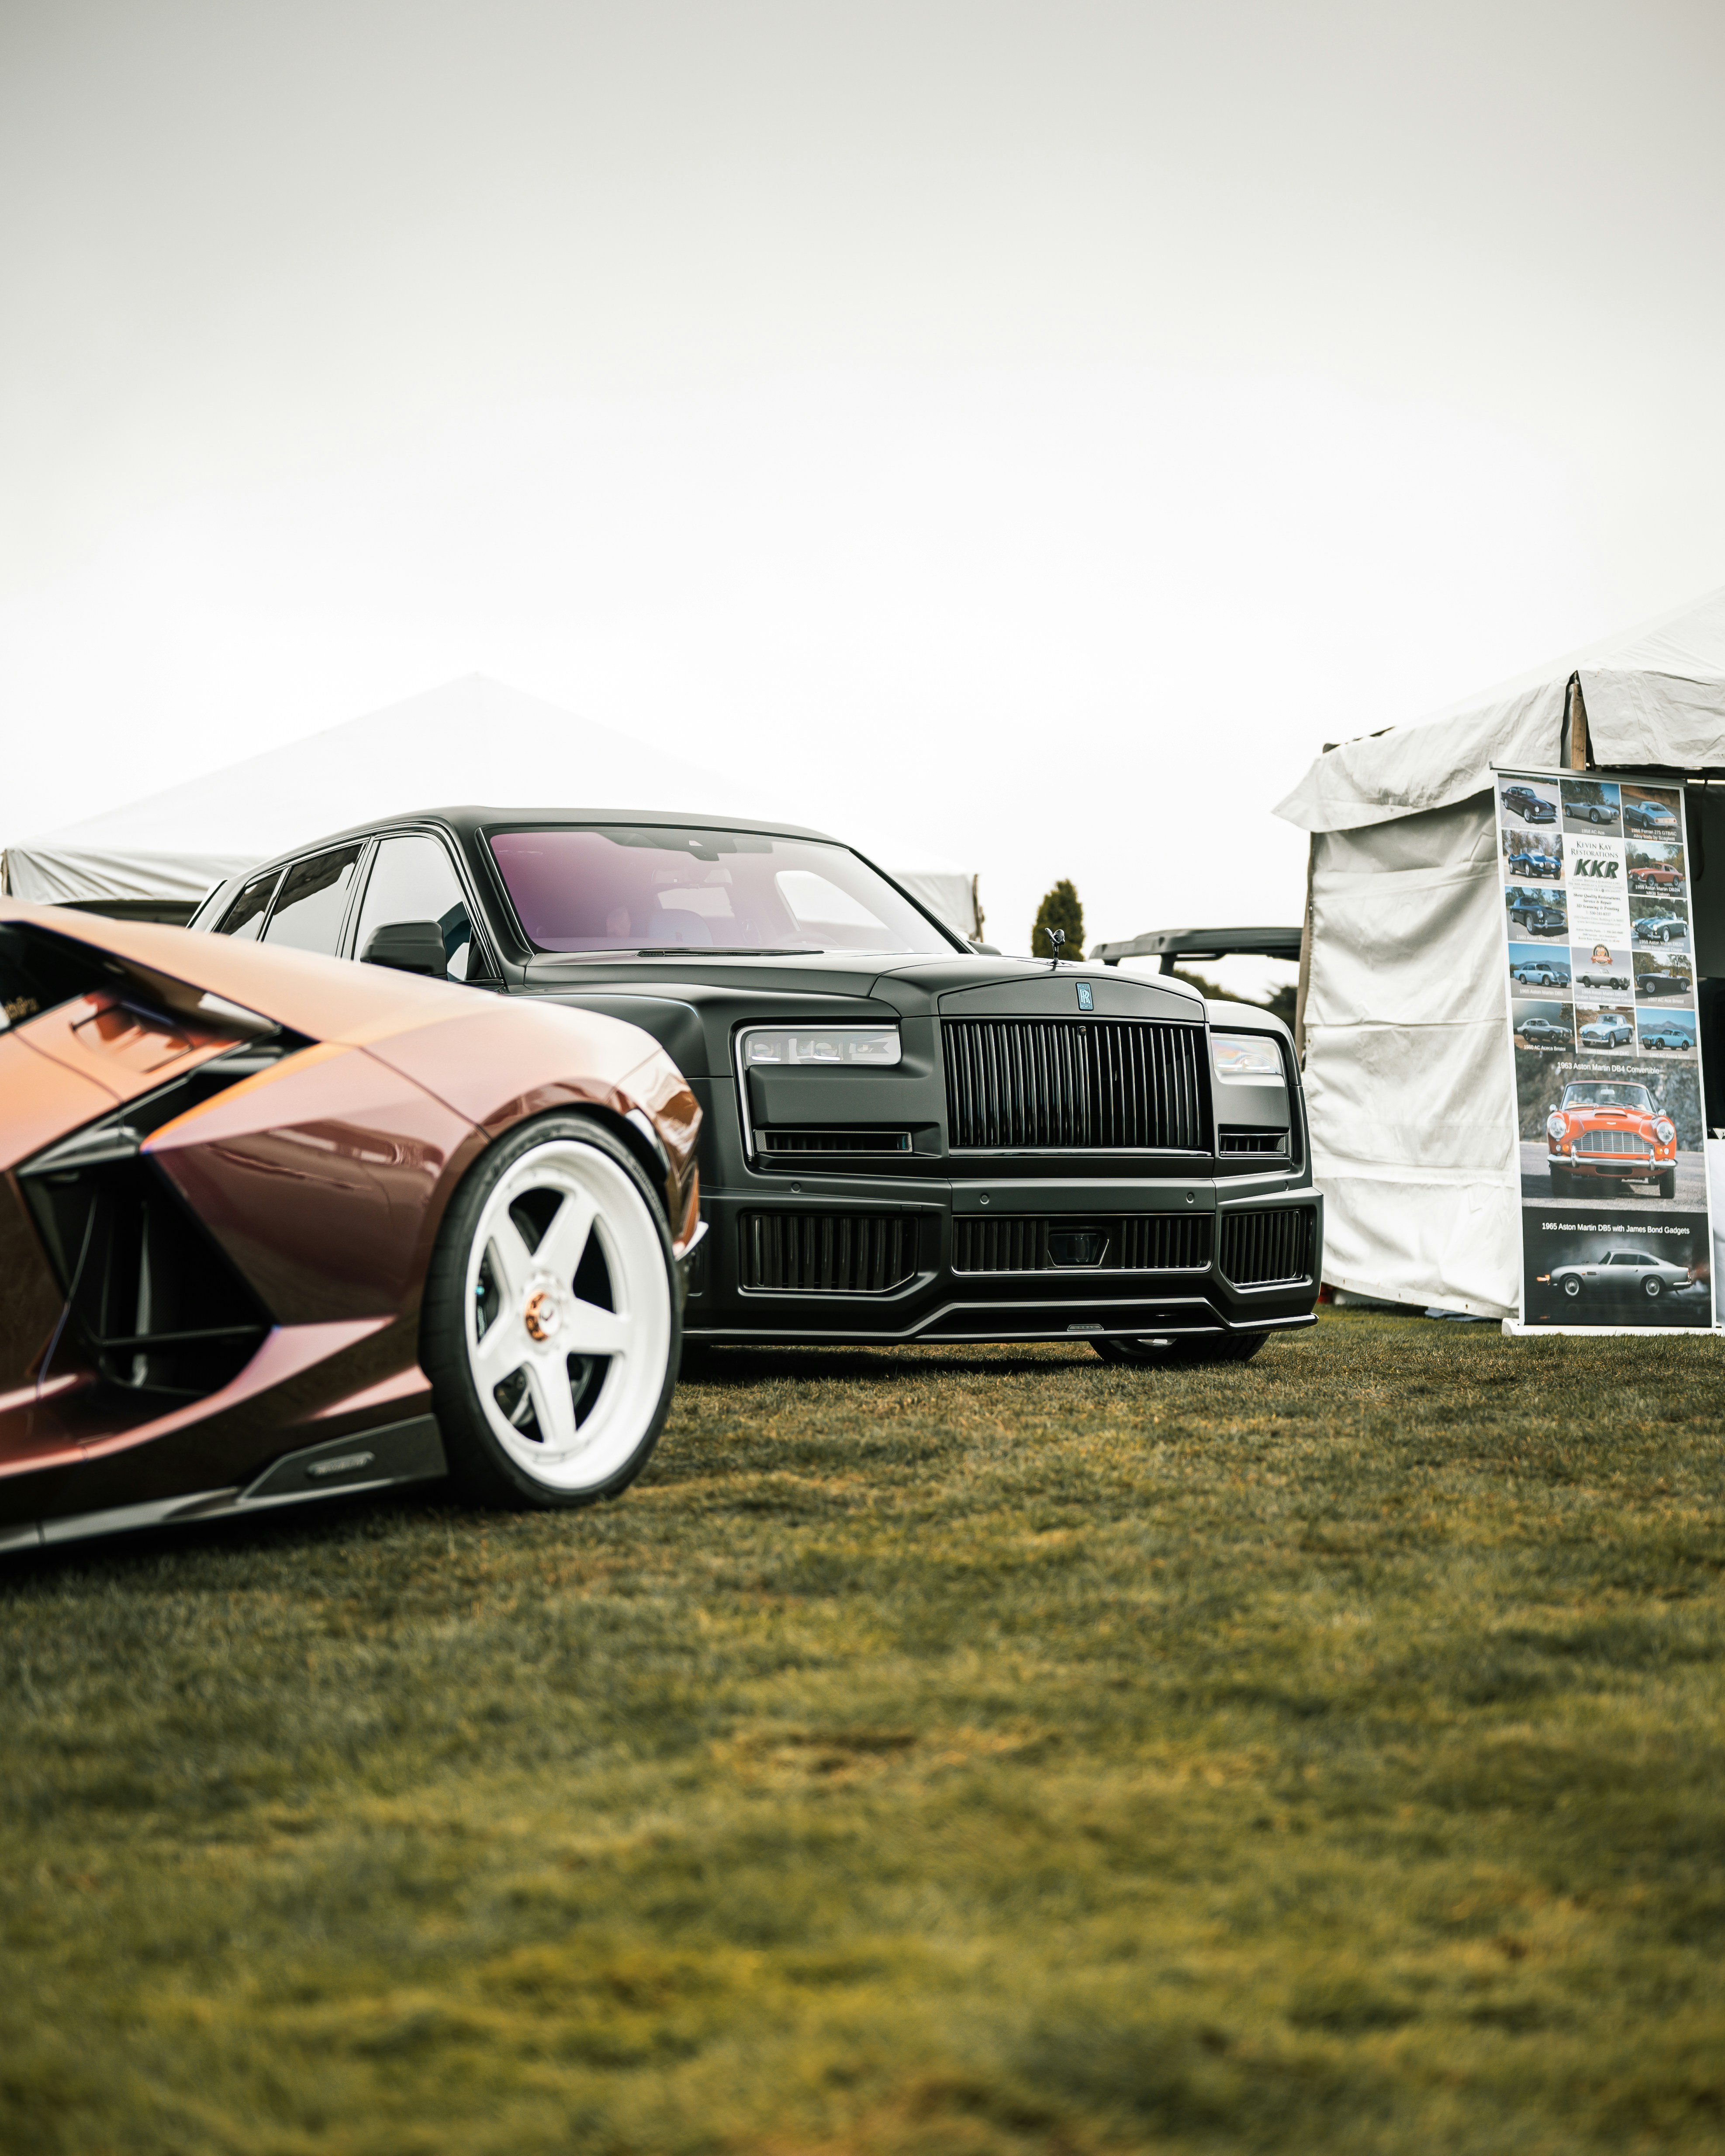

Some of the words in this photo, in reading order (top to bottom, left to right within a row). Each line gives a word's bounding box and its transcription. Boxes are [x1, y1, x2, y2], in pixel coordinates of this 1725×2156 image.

[1571, 848, 1618, 858] RESTORATIONS
[1574, 859, 1619, 879] KKR
[1557, 1061, 1573, 1070] 1963
[1626, 1066, 1659, 1075] Convertible
[1664, 1227, 1690, 1235] Gadgets
